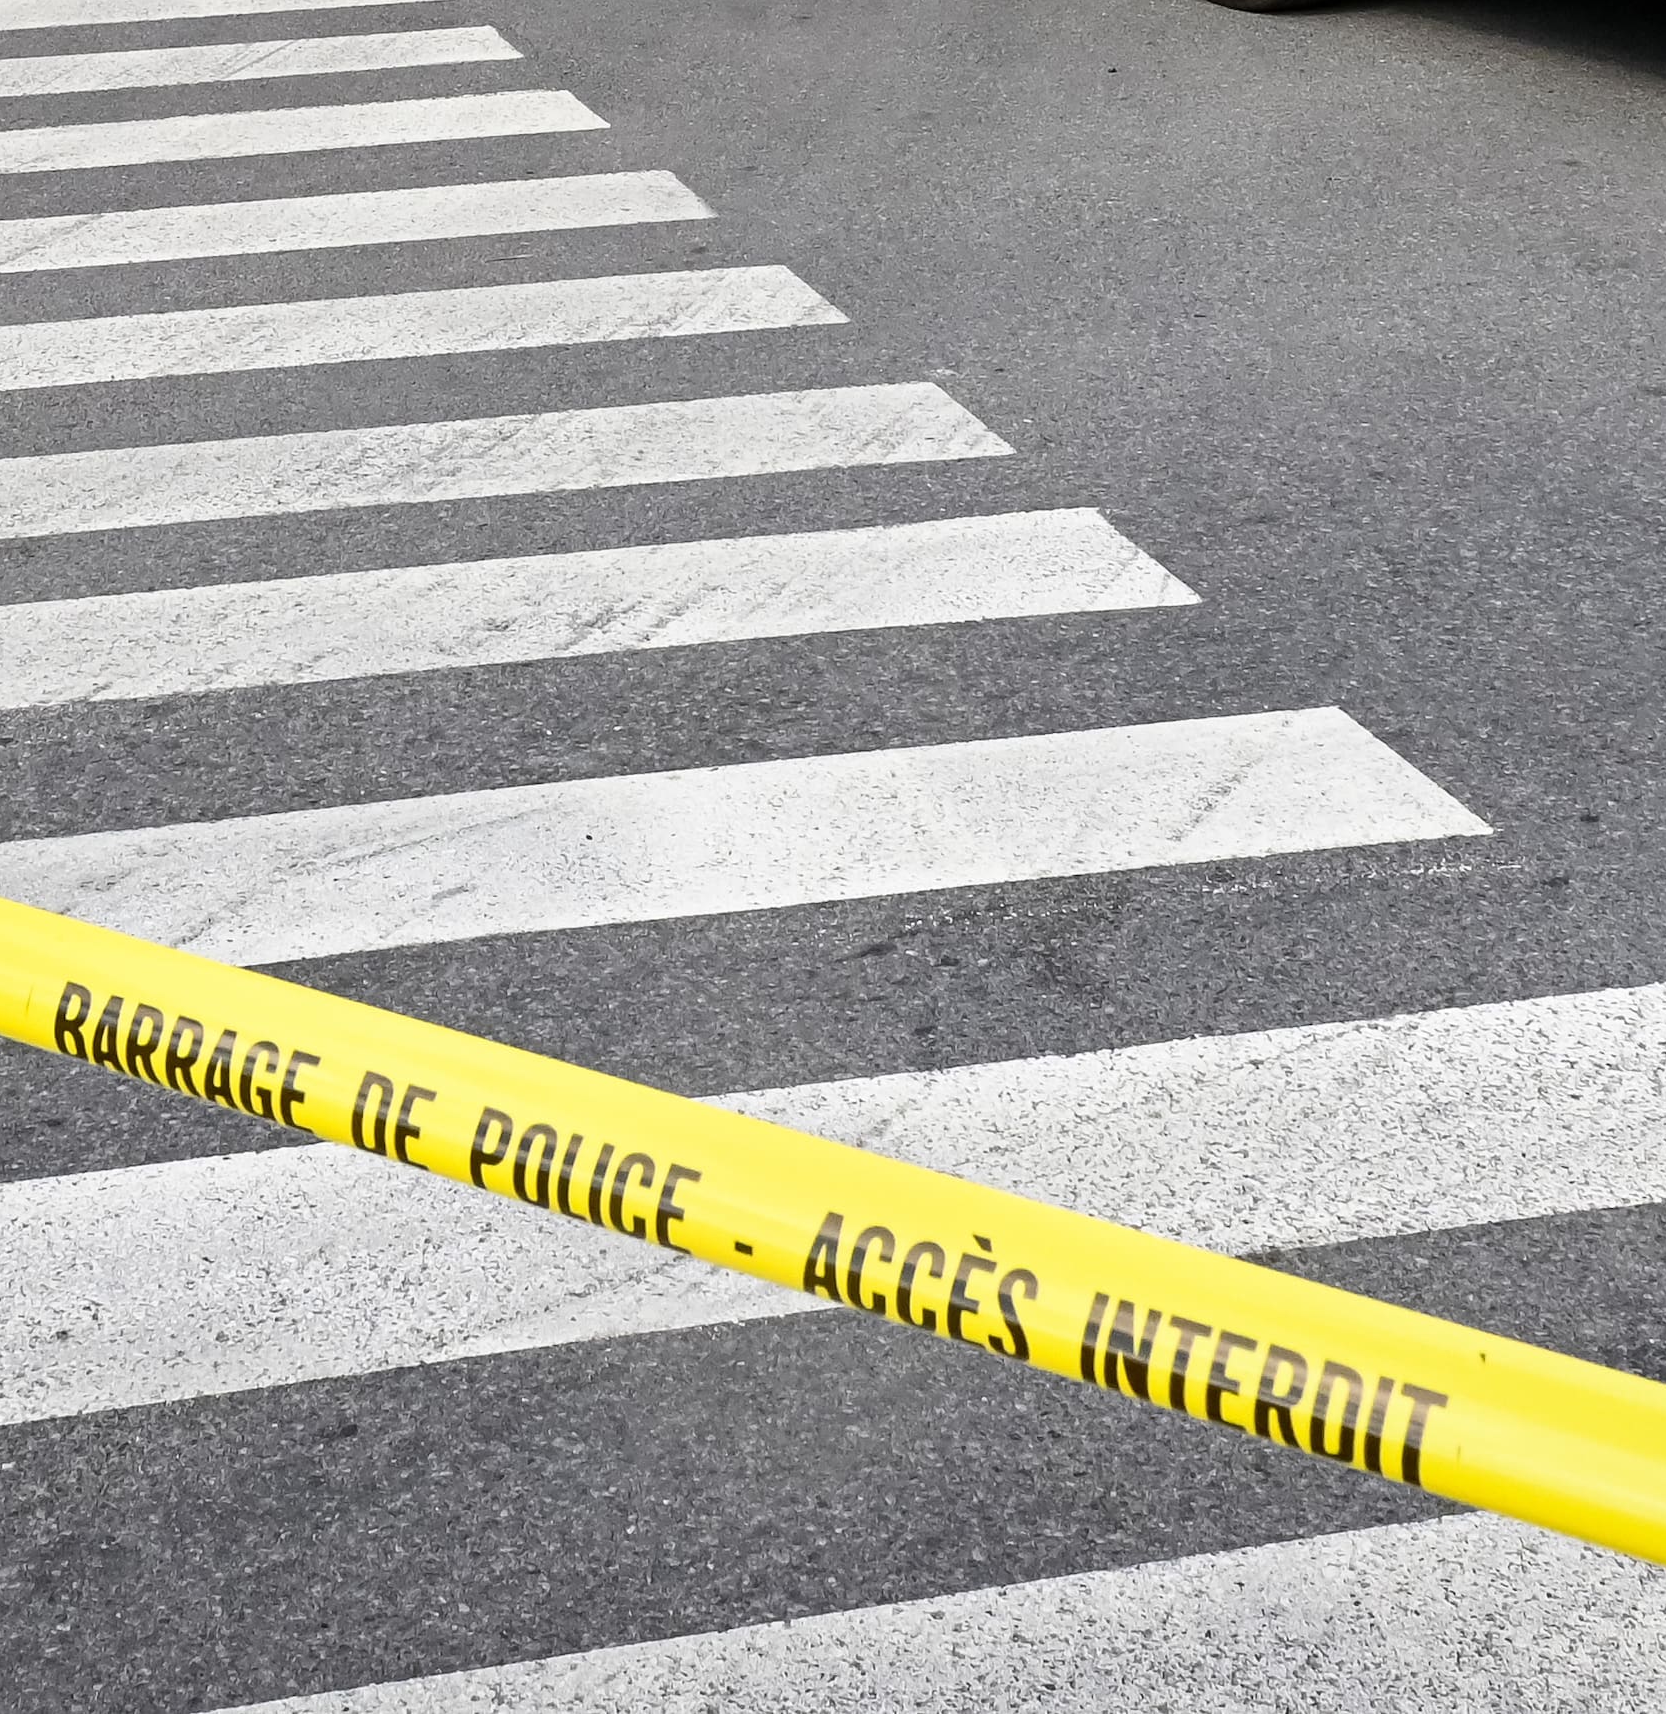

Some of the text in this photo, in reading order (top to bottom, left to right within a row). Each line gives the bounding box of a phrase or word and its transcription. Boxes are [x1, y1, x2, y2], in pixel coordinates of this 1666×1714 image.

[53, 980, 322, 1134] BARRAGE
[349, 1070, 438, 1171] DE
[469, 1106, 703, 1256] POLICE
[802, 1210, 1041, 1364] ACCÈS
[1078, 1290, 1451, 1488] INTERDIT
